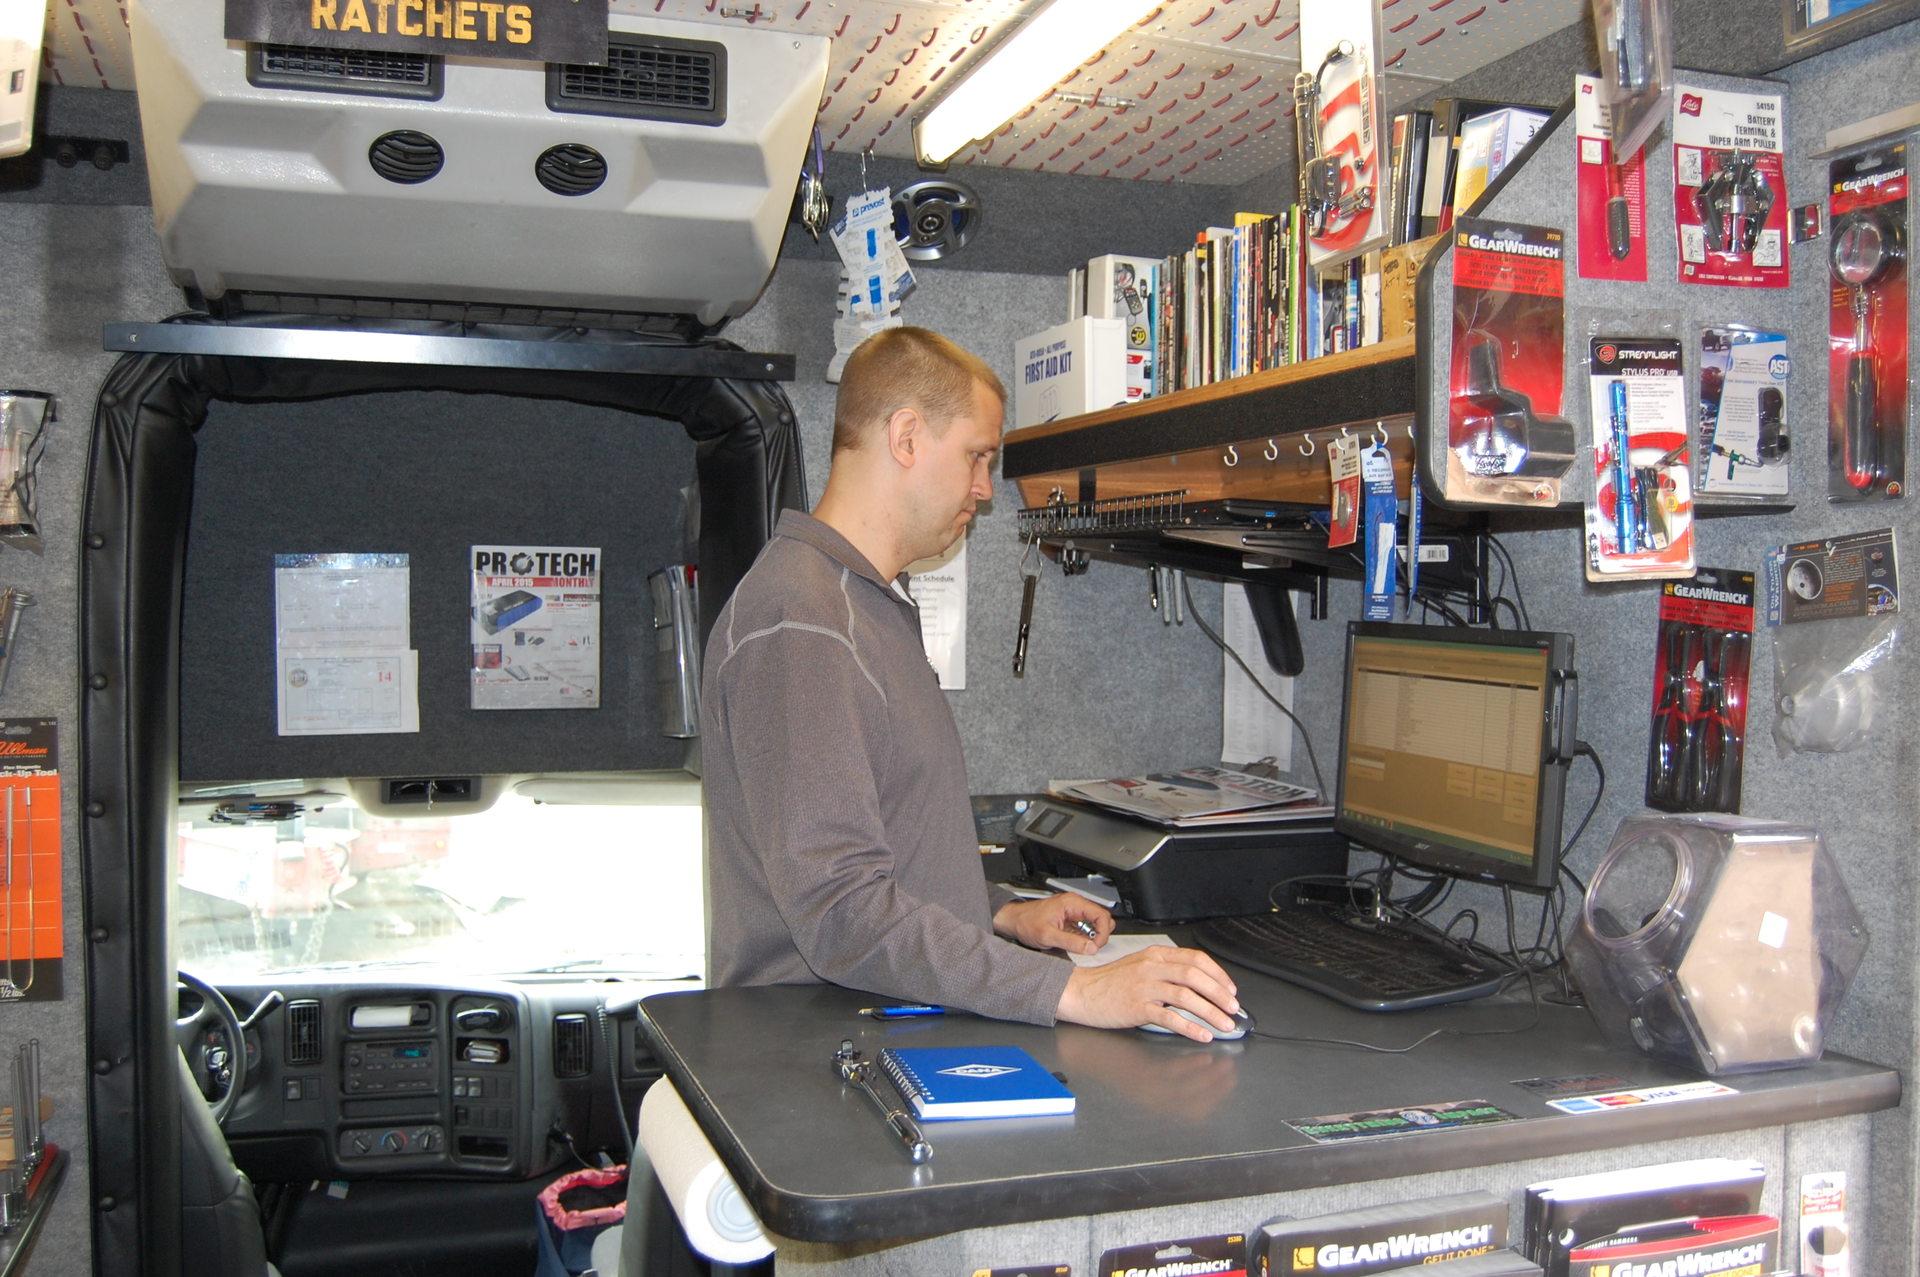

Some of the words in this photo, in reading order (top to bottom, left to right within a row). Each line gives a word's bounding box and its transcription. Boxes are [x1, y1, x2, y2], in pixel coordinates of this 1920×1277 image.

[311, 0, 533, 44] RATCHETS
[1756, 102, 1775, 111] 54150
[1747, 114, 1776, 126] BATTERY
[1735, 125, 1768, 137] TERMINAL
[1770, 128, 1776, 138] &
[1709, 135, 1732, 146] WIPER
[1734, 137, 1750, 147] ARM
[1753, 138, 1776, 149] PULLER
[1841, 167, 1906, 191] GEARWRENCH
[860, 197, 885, 215] prevost
[1468, 234, 1559, 259] GEARWRENCH
[1618, 350, 1678, 360] STREAMLIGHT
[1025, 360, 1045, 385] FIRST
[1046, 356, 1058, 378] AID
[1060, 351, 1072, 374] KIT
[1621, 368, 1648, 377] STYLUS
[1770, 359, 1790, 374] AST
[492, 578, 514, 587] APRIL
[514, 578, 534, 587] 2015
[552, 577, 595, 588] MONTHLY
[1673, 583, 1748, 605] GEARWRENCH
[378, 671, 392, 682] 14
[0, 770, 33, 778] ck-Up
[34, 768, 58, 777] Tool
[1647, 1091, 1680, 1101] VISA
[1317, 1224, 1489, 1269] GEARWRENCH
[1609, 1236, 1638, 1246] HAMMERS
[1611, 1244, 1763, 1277] GEARWRENCH
[1125, 1258, 1230, 1277] GEARWRENCH
